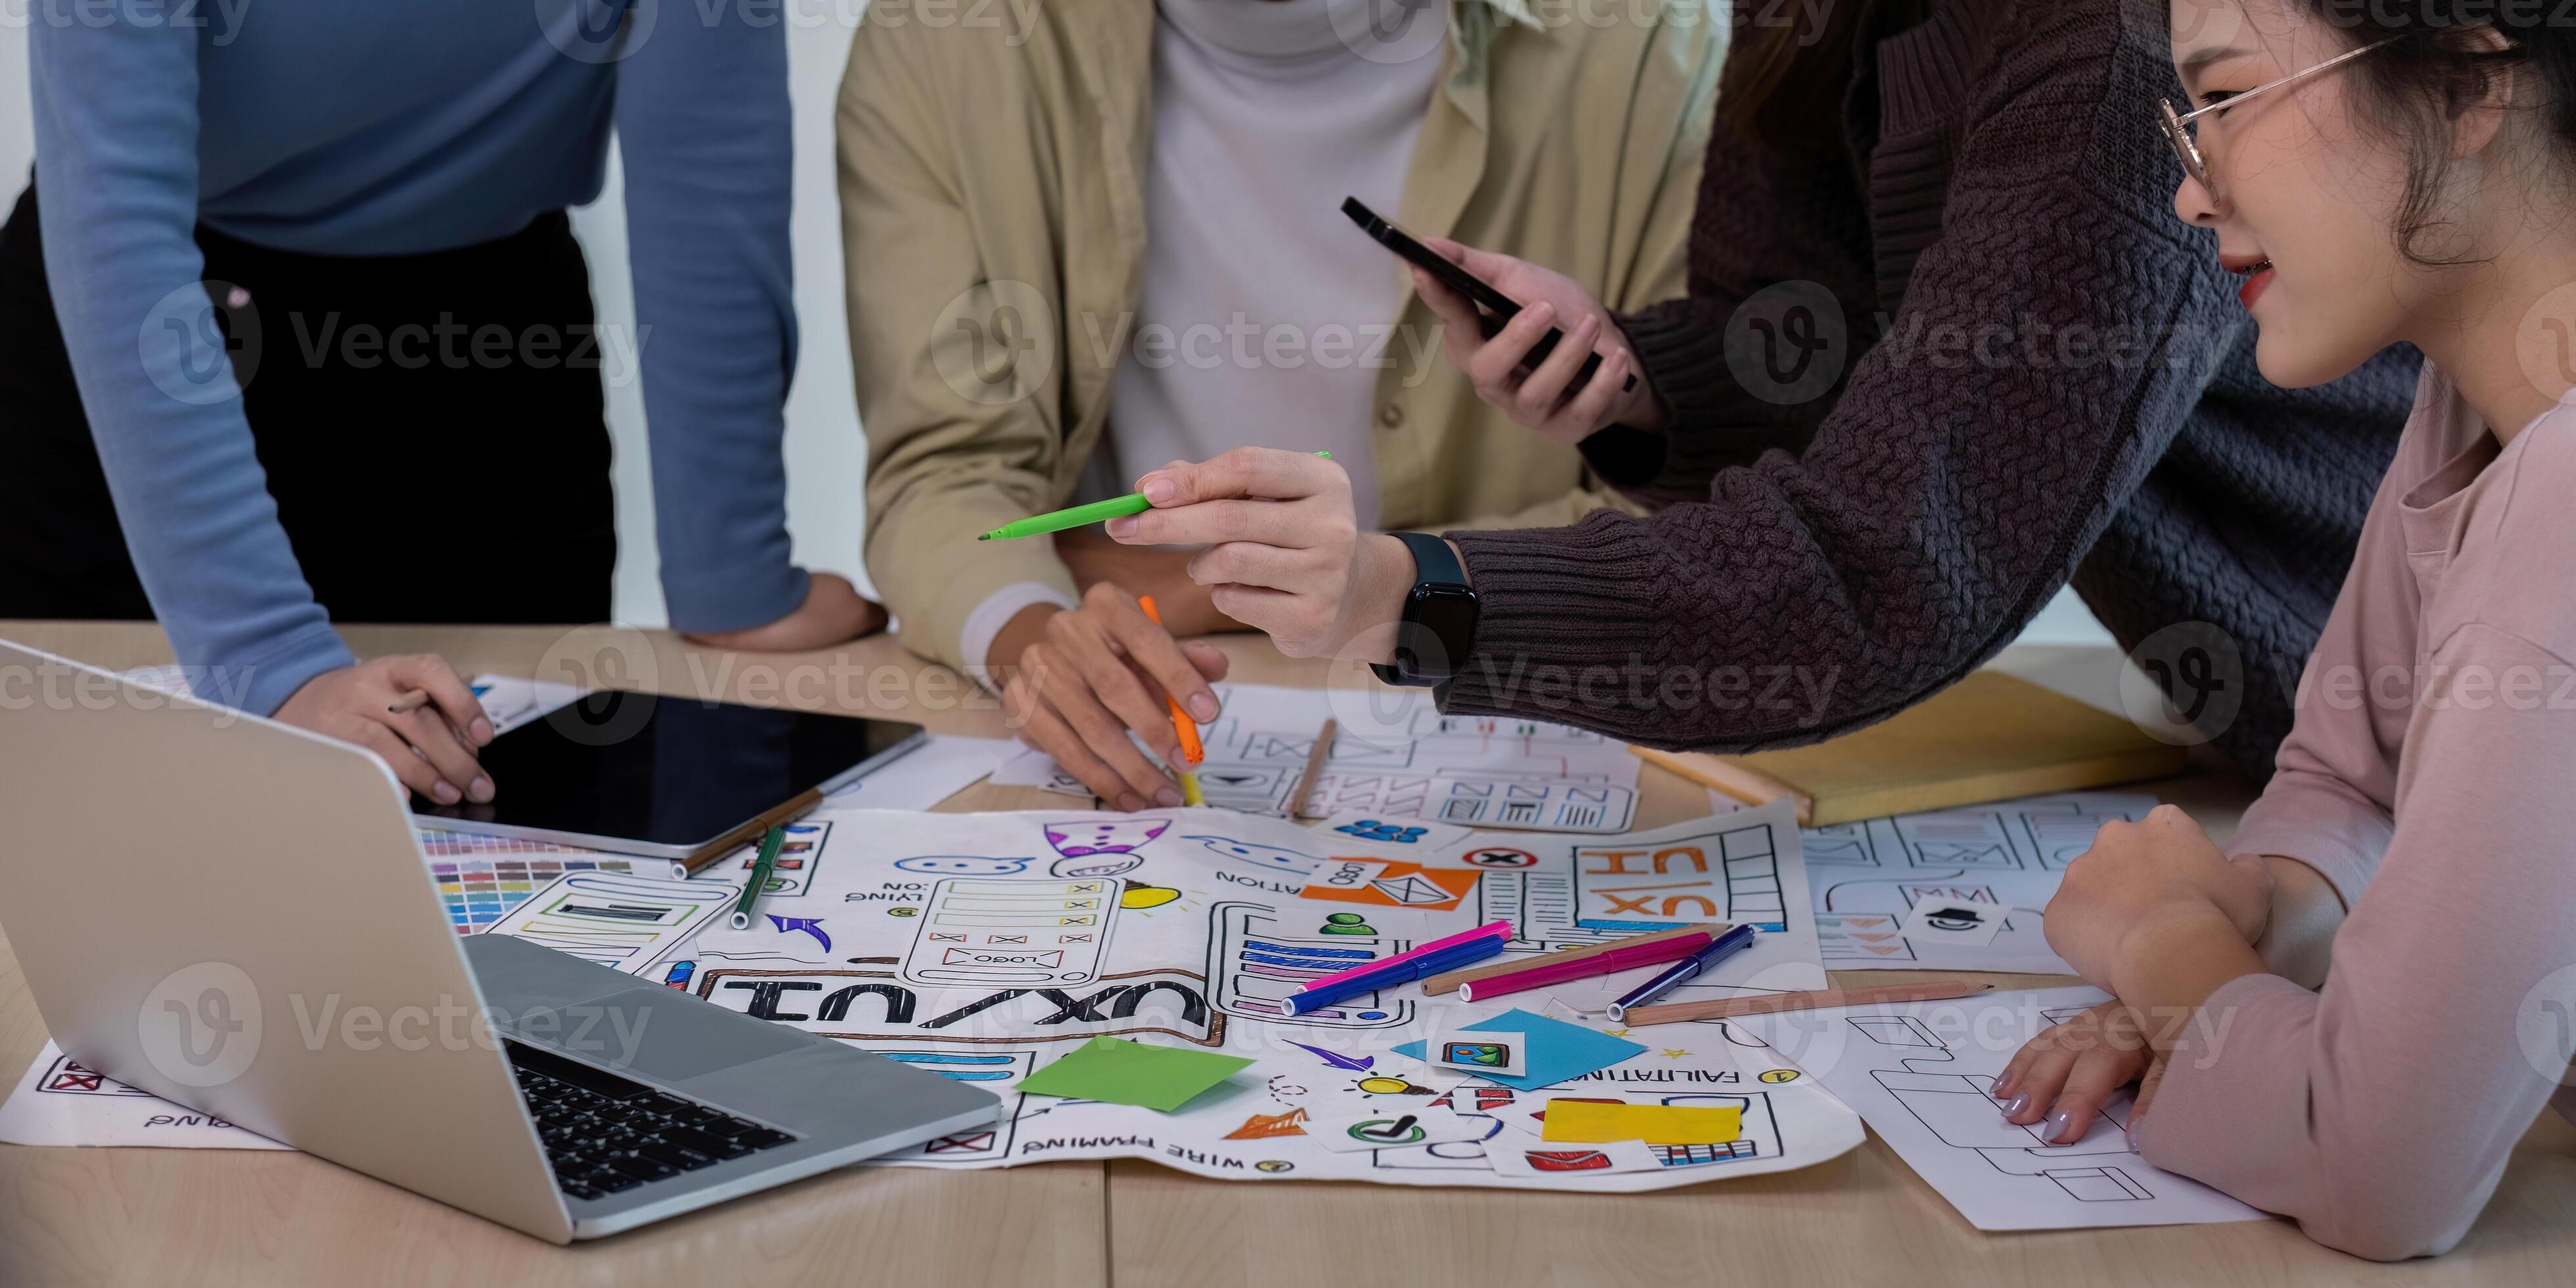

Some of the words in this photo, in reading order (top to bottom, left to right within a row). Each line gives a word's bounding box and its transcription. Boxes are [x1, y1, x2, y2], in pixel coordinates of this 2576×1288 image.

[973, 954, 1038, 964] LOGO
[724, 980, 1207, 1029] UX/UI
[1022, 1135, 1155, 1155] FRAMING
[1166, 1143, 1245, 1170] WIRE
